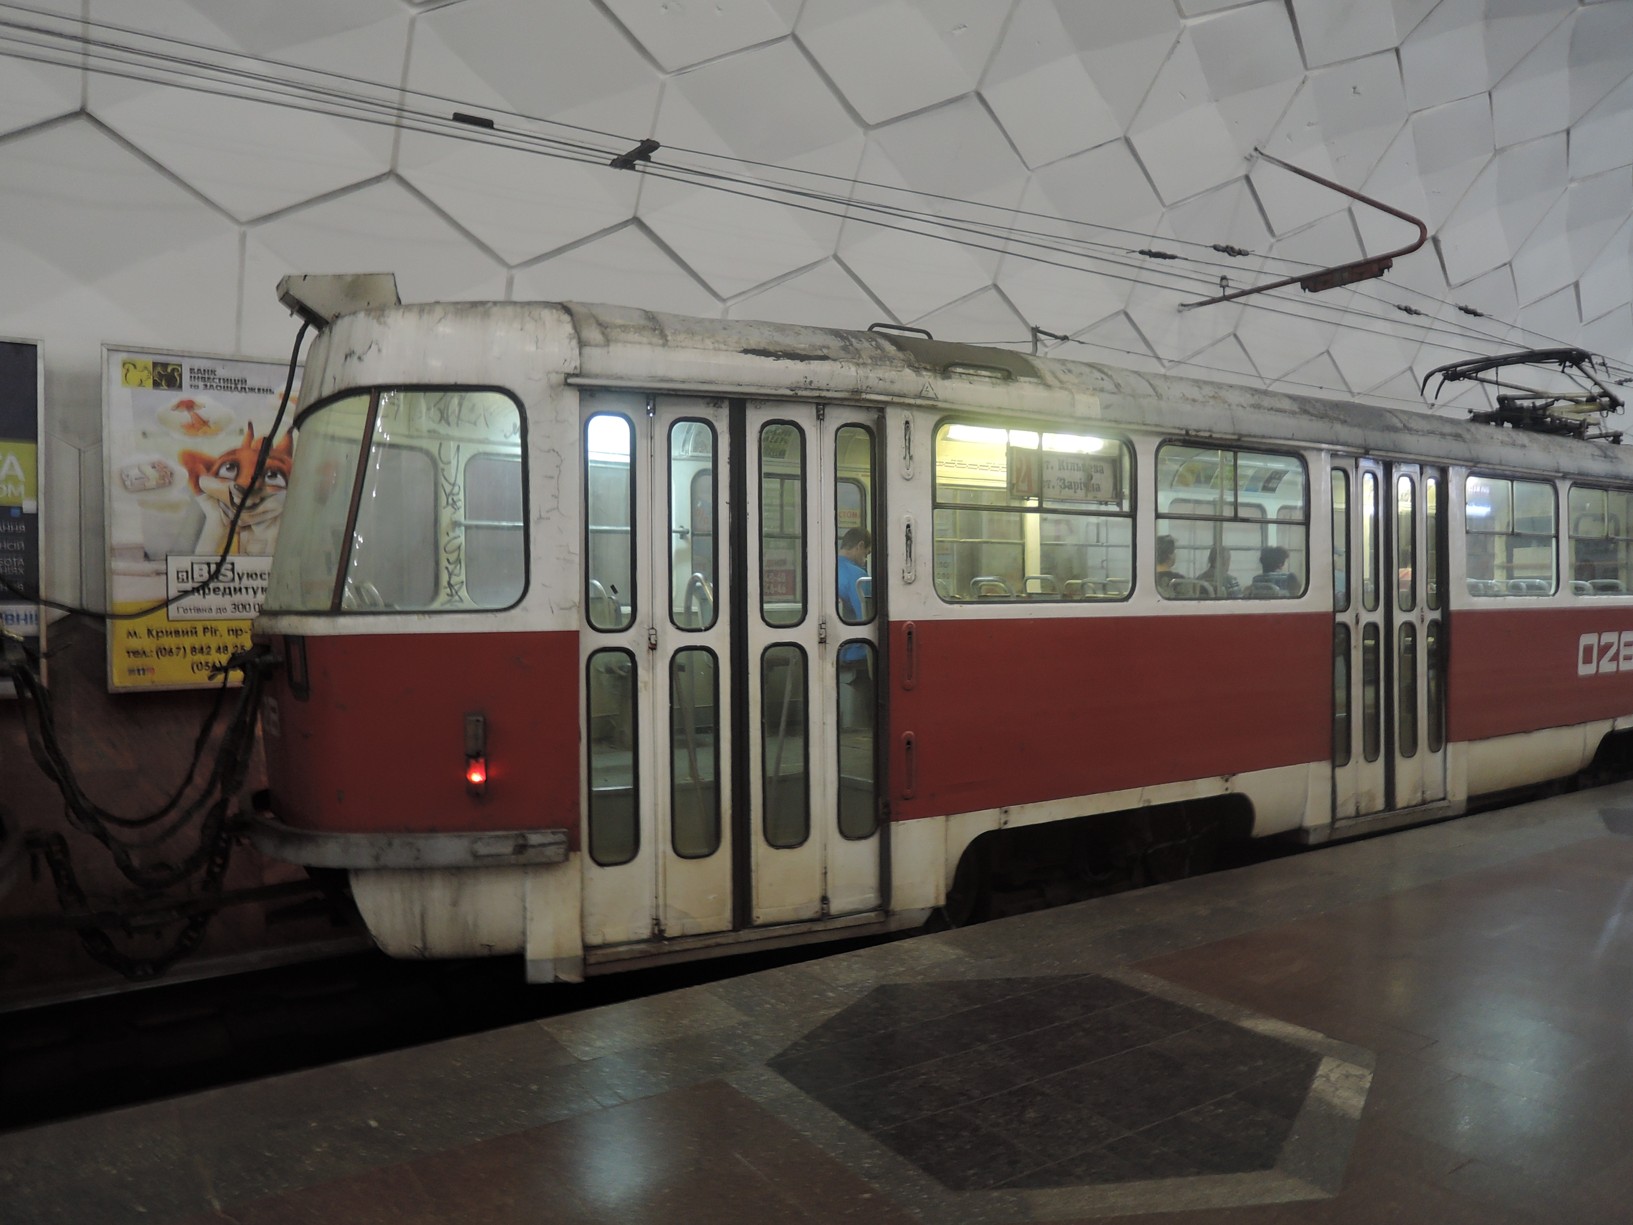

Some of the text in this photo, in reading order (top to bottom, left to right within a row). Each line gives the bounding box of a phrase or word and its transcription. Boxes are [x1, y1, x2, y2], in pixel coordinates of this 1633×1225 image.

[231, 603, 251, 613] 300
[147, 627, 198, 640] Кривий
[190, 646, 212, 656] 842
[216, 645, 229, 655] 48
